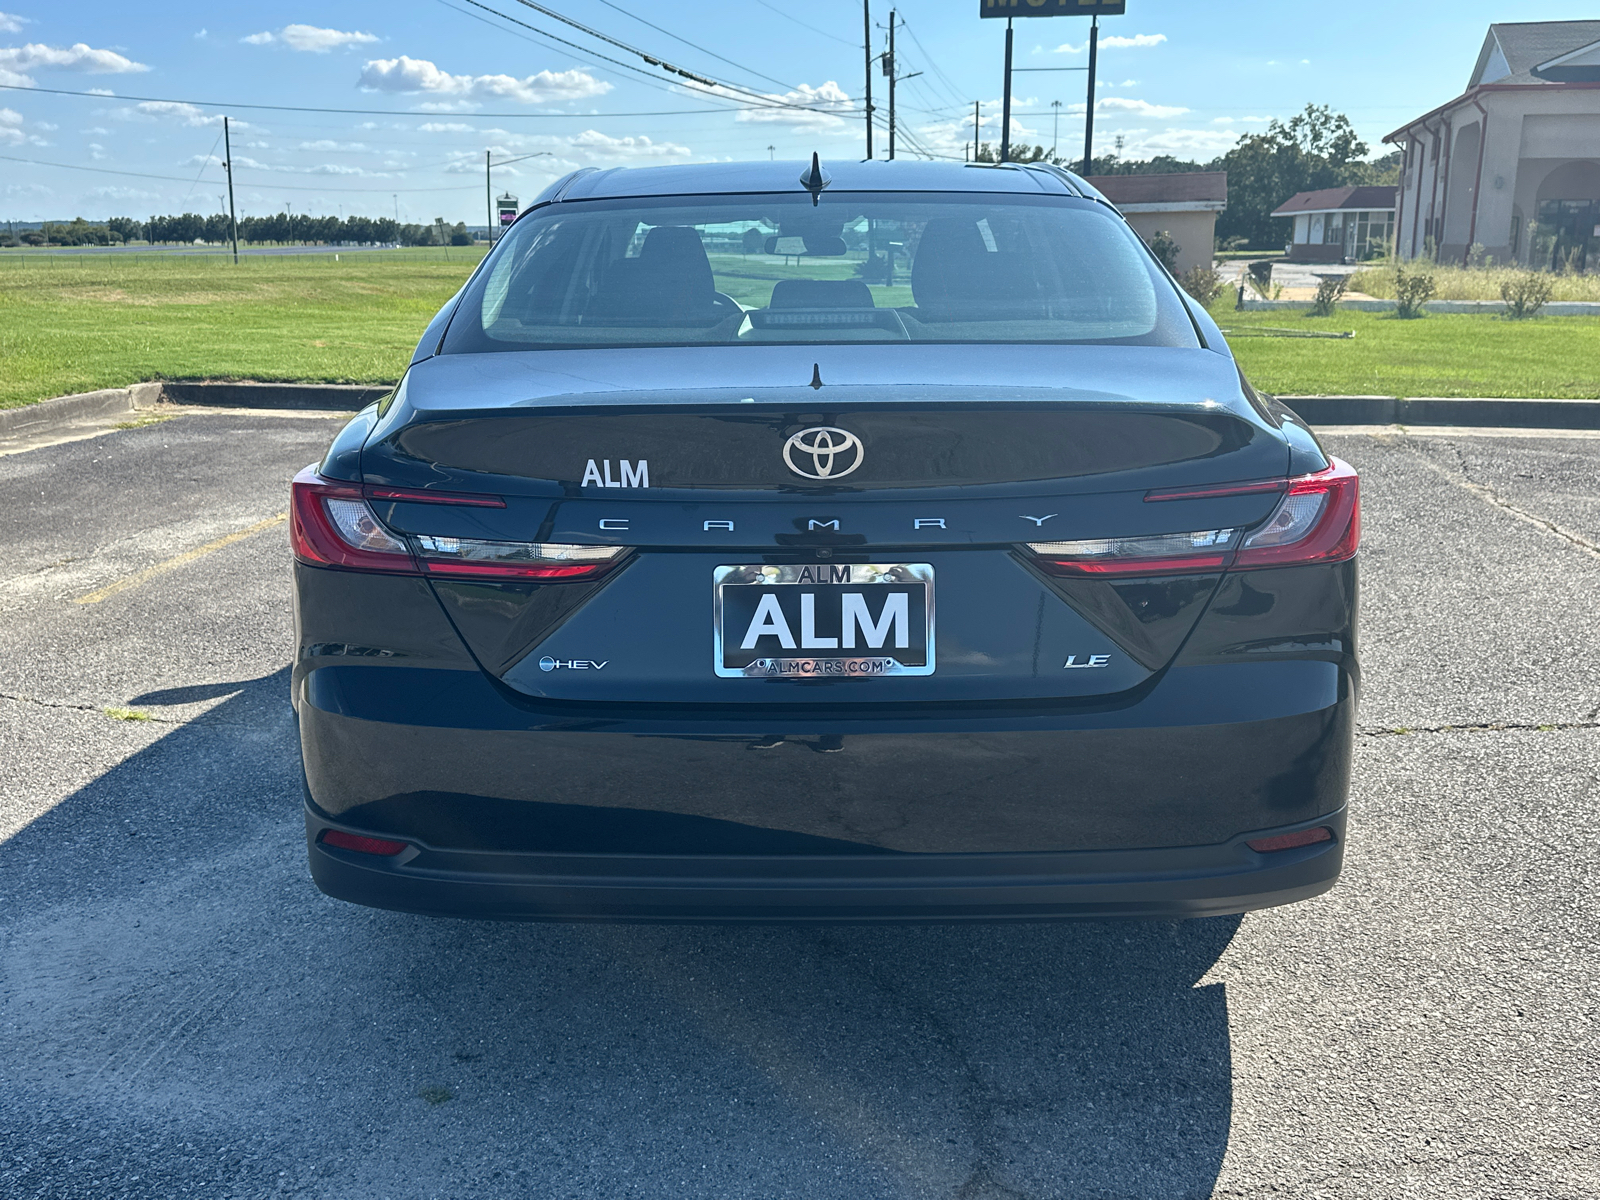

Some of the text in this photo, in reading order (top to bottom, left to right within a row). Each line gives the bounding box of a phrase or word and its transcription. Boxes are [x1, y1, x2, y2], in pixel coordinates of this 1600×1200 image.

[581, 459, 649, 488] ALM
[599, 514, 1058, 531] CAMRY
[797, 565, 851, 583] ALM
[740, 592, 909, 649] ALM
[555, 659, 609, 670] HEV
[767, 660, 884, 674] ALMCARS.COM
[1063, 654, 1111, 669] LE
